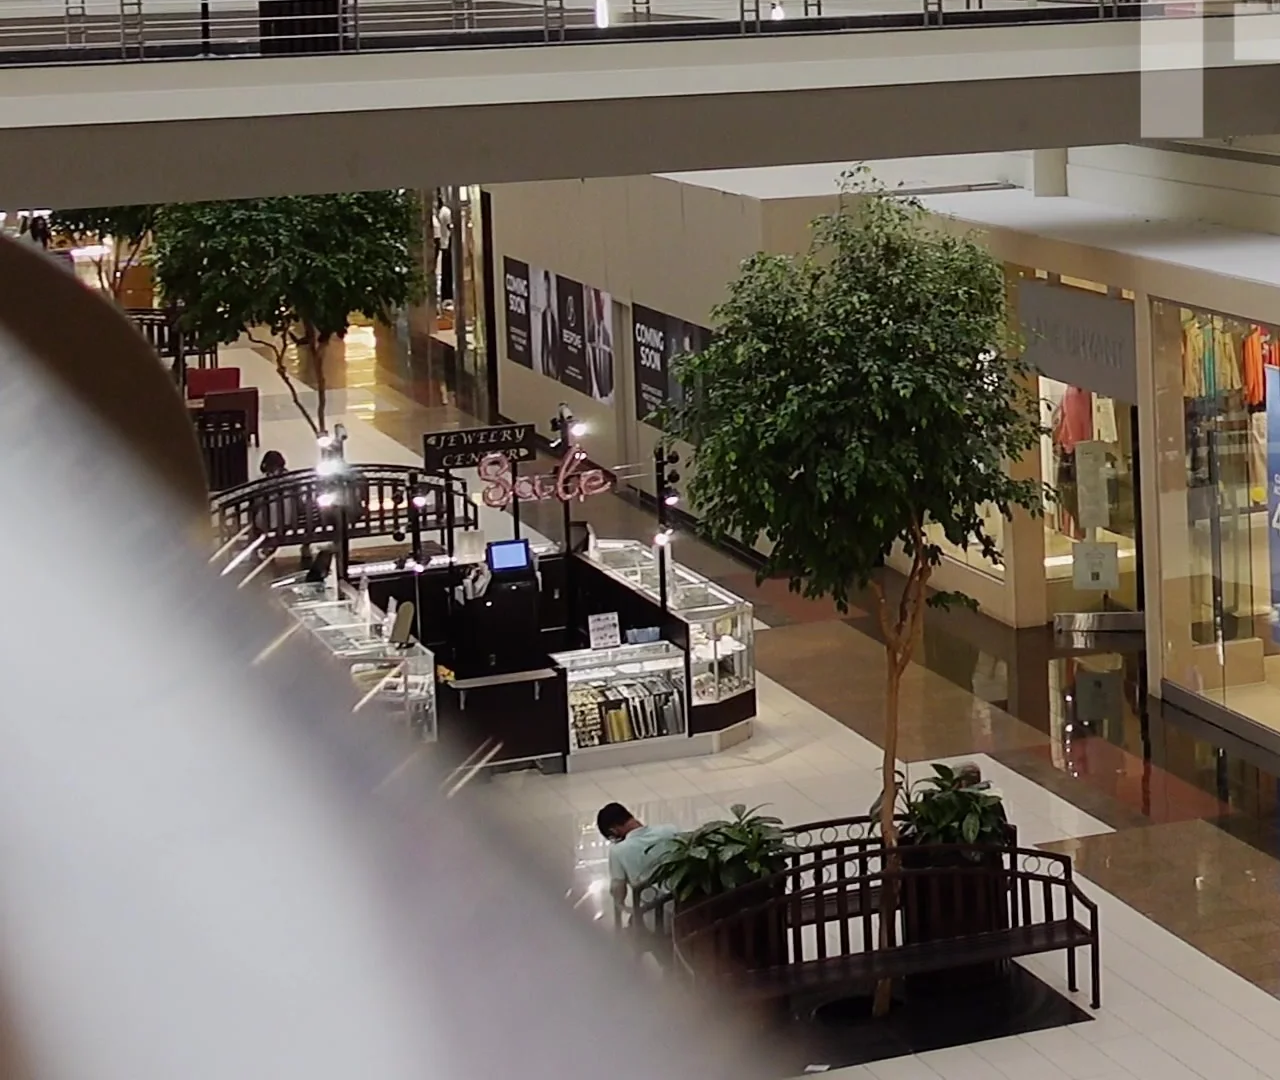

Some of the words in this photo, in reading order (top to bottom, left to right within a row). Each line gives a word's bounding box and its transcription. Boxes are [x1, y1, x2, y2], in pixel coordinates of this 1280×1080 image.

[635, 322, 664, 351] COMING
[640, 346, 661, 372] SOON
[437, 427, 526, 449] JEWELRY
[442, 448, 519, 466] CENR
